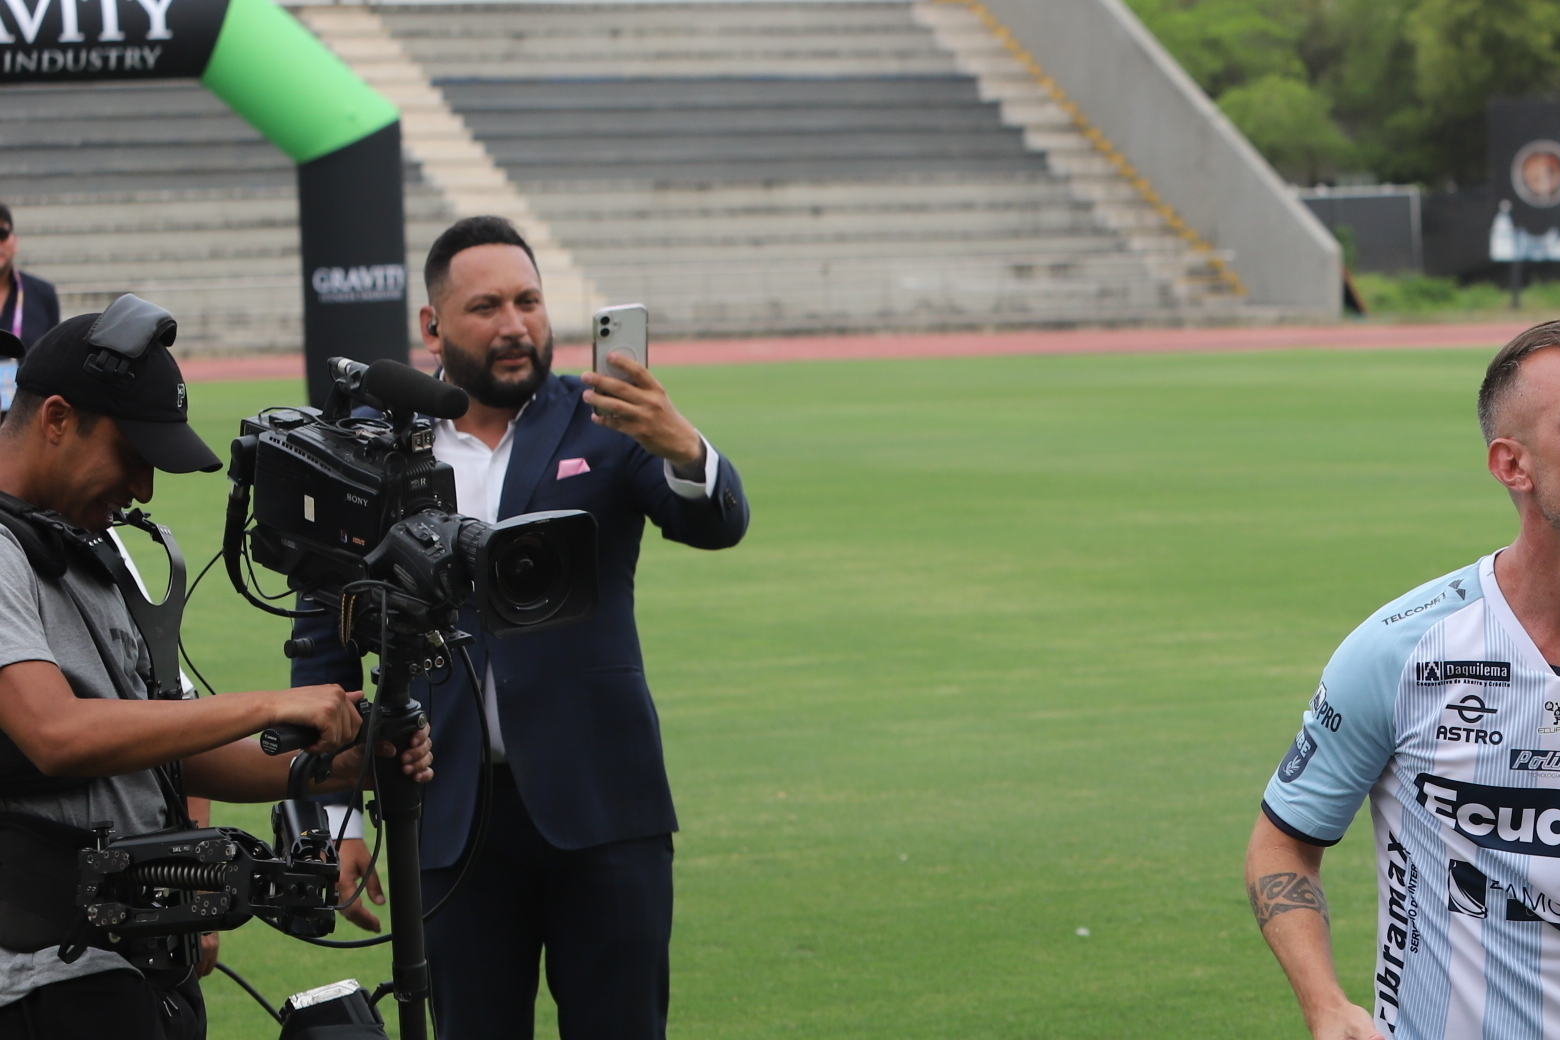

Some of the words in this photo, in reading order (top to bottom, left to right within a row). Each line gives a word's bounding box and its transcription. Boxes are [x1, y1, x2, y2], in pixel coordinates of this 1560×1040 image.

[0, 0, 174, 44] VITY
[3, 45, 162, 73] INDUSTRY
[346, 493, 369, 507] SONY
[1381, 590, 1447, 626] TELCONET
[1446, 662, 1509, 677] Daquilema
[1416, 680, 1453, 688] Cooperativa
[1316, 700, 1342, 733] PRO
[1436, 725, 1503, 745] ASTRO
